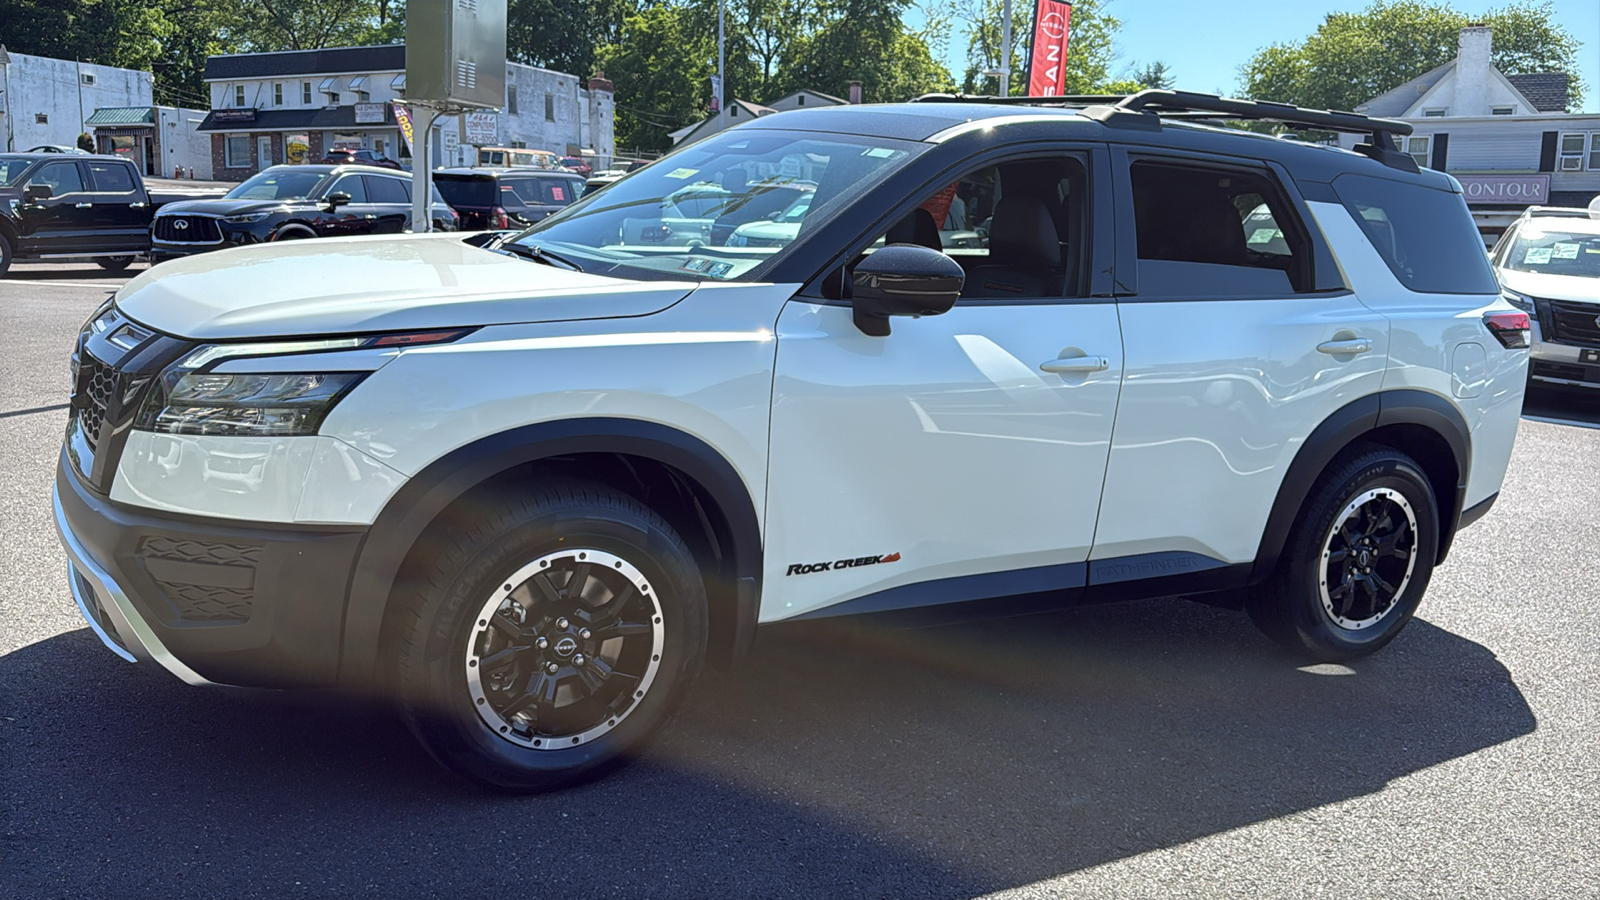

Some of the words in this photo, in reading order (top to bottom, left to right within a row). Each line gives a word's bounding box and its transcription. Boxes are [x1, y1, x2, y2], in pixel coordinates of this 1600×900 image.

[1040, 21, 1065, 31] NISSA
[467, 121, 496, 130] COMPUTERS
[1096, 556, 1199, 578] PATHFINDER
